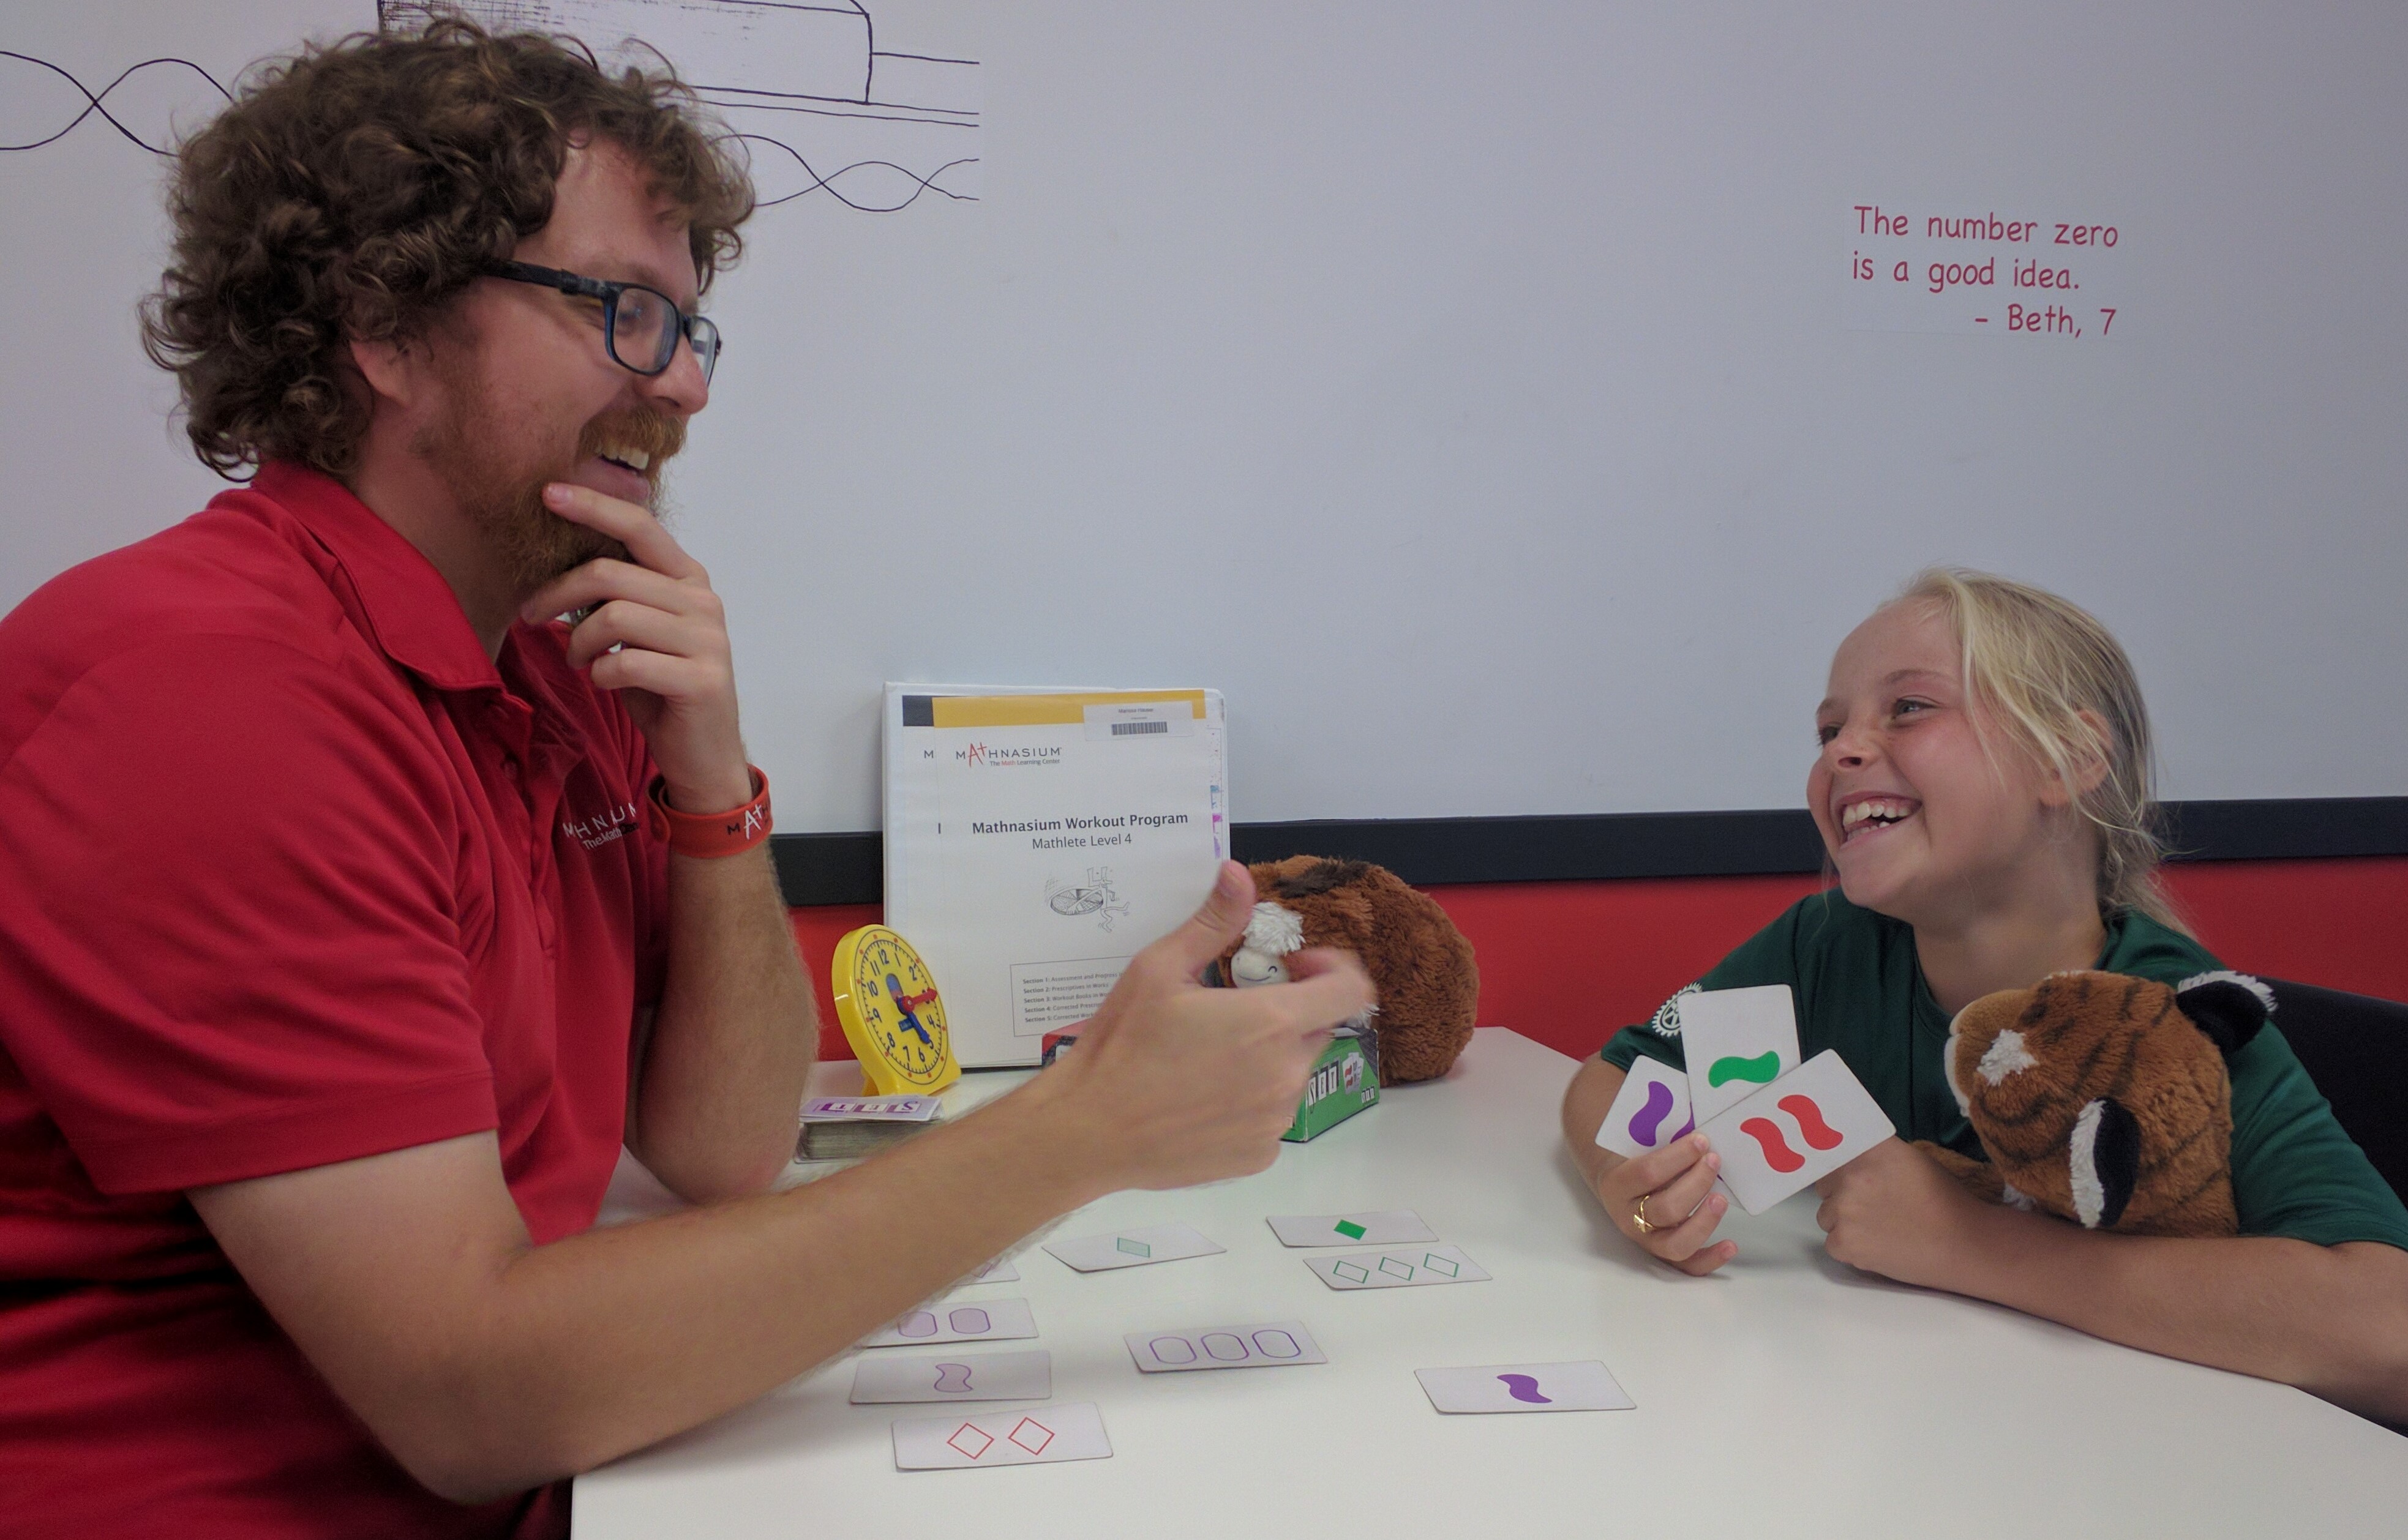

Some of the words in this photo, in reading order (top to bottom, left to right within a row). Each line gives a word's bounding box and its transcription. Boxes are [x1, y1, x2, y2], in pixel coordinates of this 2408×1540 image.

[1854, 206, 1908, 236] The
[1928, 212, 2038, 242] number
[2054, 223, 2118, 247] zero
[1853, 250, 1874, 280] is
[1893, 261, 1909, 282] a
[1929, 256, 1994, 293] good
[2014, 259, 2079, 290] idea.
[2008, 303, 2082, 338] Beth,
[2100, 308, 2117, 335] 7
[972, 819, 1061, 834] Mathnasium
[1065, 815, 1125, 829] Workout
[1130, 814, 1188, 827] Program
[1032, 836, 1086, 850] Mathlete
[1091, 834, 1121, 847] Level
[1124, 833, 1131, 844] 4
[878, 949, 890, 965] 12
[895, 952, 901, 967] 1
[870, 960, 880, 976] 11
[909, 966, 917, 981] 2
[867, 981, 878, 997] 10
[872, 1008, 882, 1023] 9
[926, 1014, 936, 1028] 4
[887, 1032, 895, 1047] 8
[902, 1045, 910, 1062] 7
[918, 1047, 925, 1062] 6
